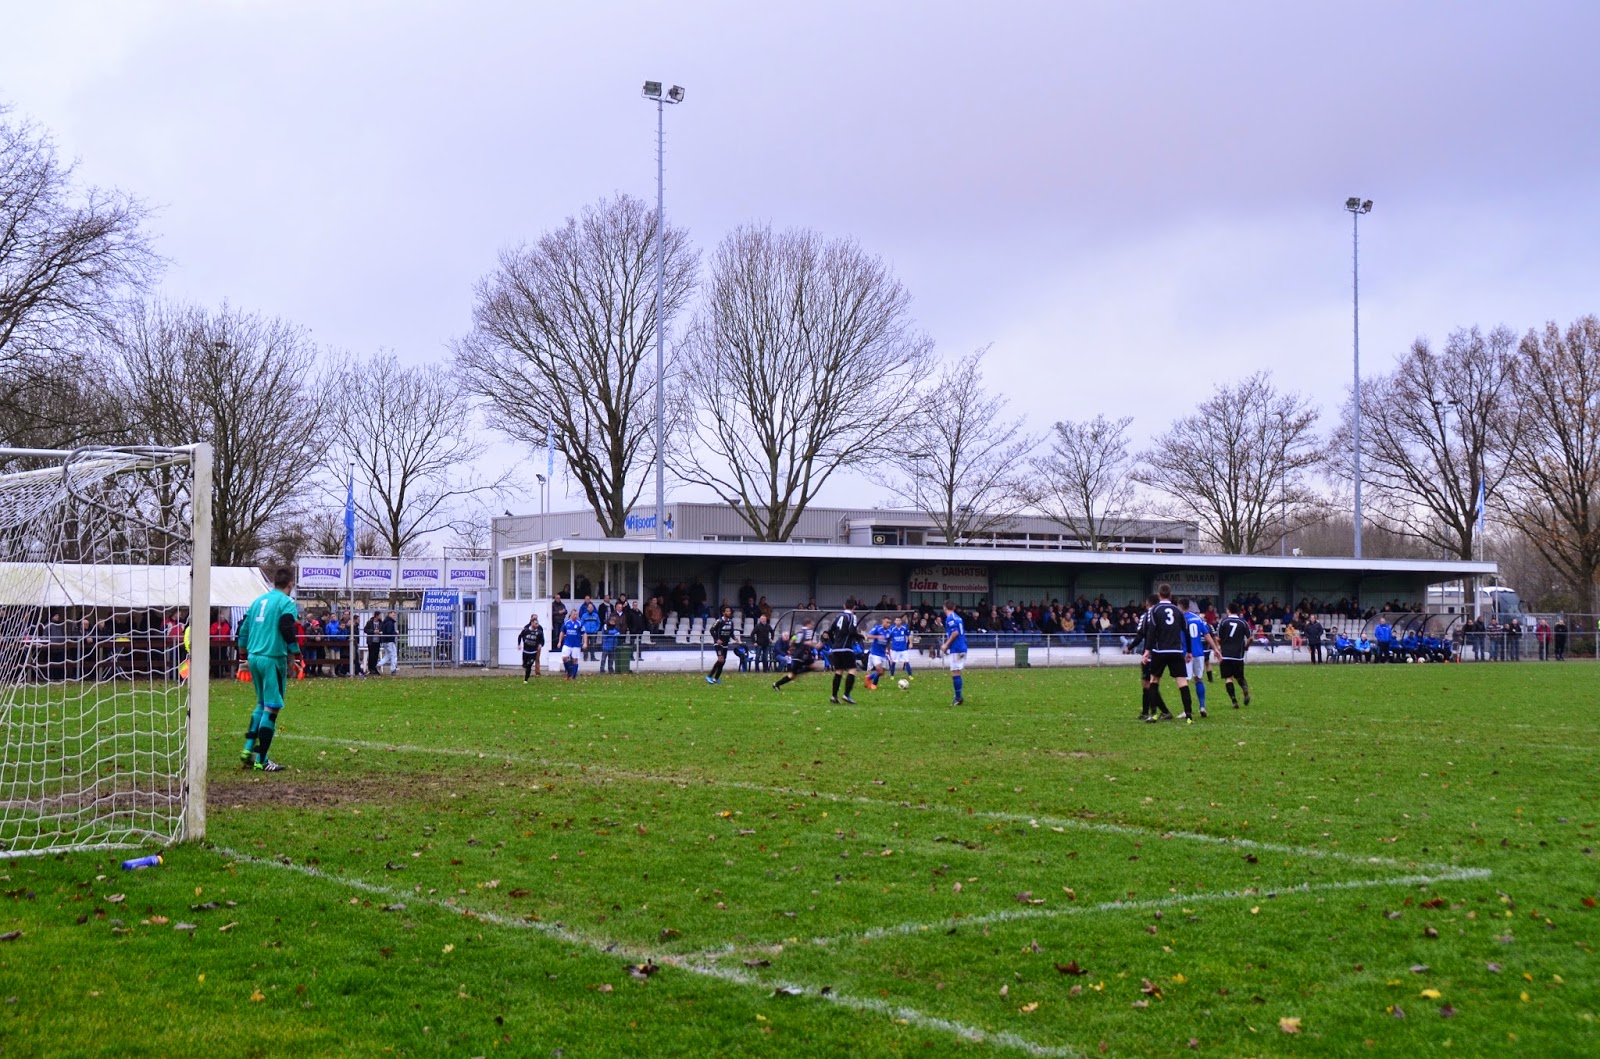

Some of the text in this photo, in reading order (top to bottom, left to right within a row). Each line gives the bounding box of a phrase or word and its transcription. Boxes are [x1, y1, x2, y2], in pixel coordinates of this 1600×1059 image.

[354, 569, 391, 577] SCHOUTEN
[942, 567, 987, 577] DAIHATSU
[255, 598, 269, 622] 1
[1164, 607, 1175, 625] 3
[836, 615, 844, 630] 4
[1229, 622, 1238, 638] 7
